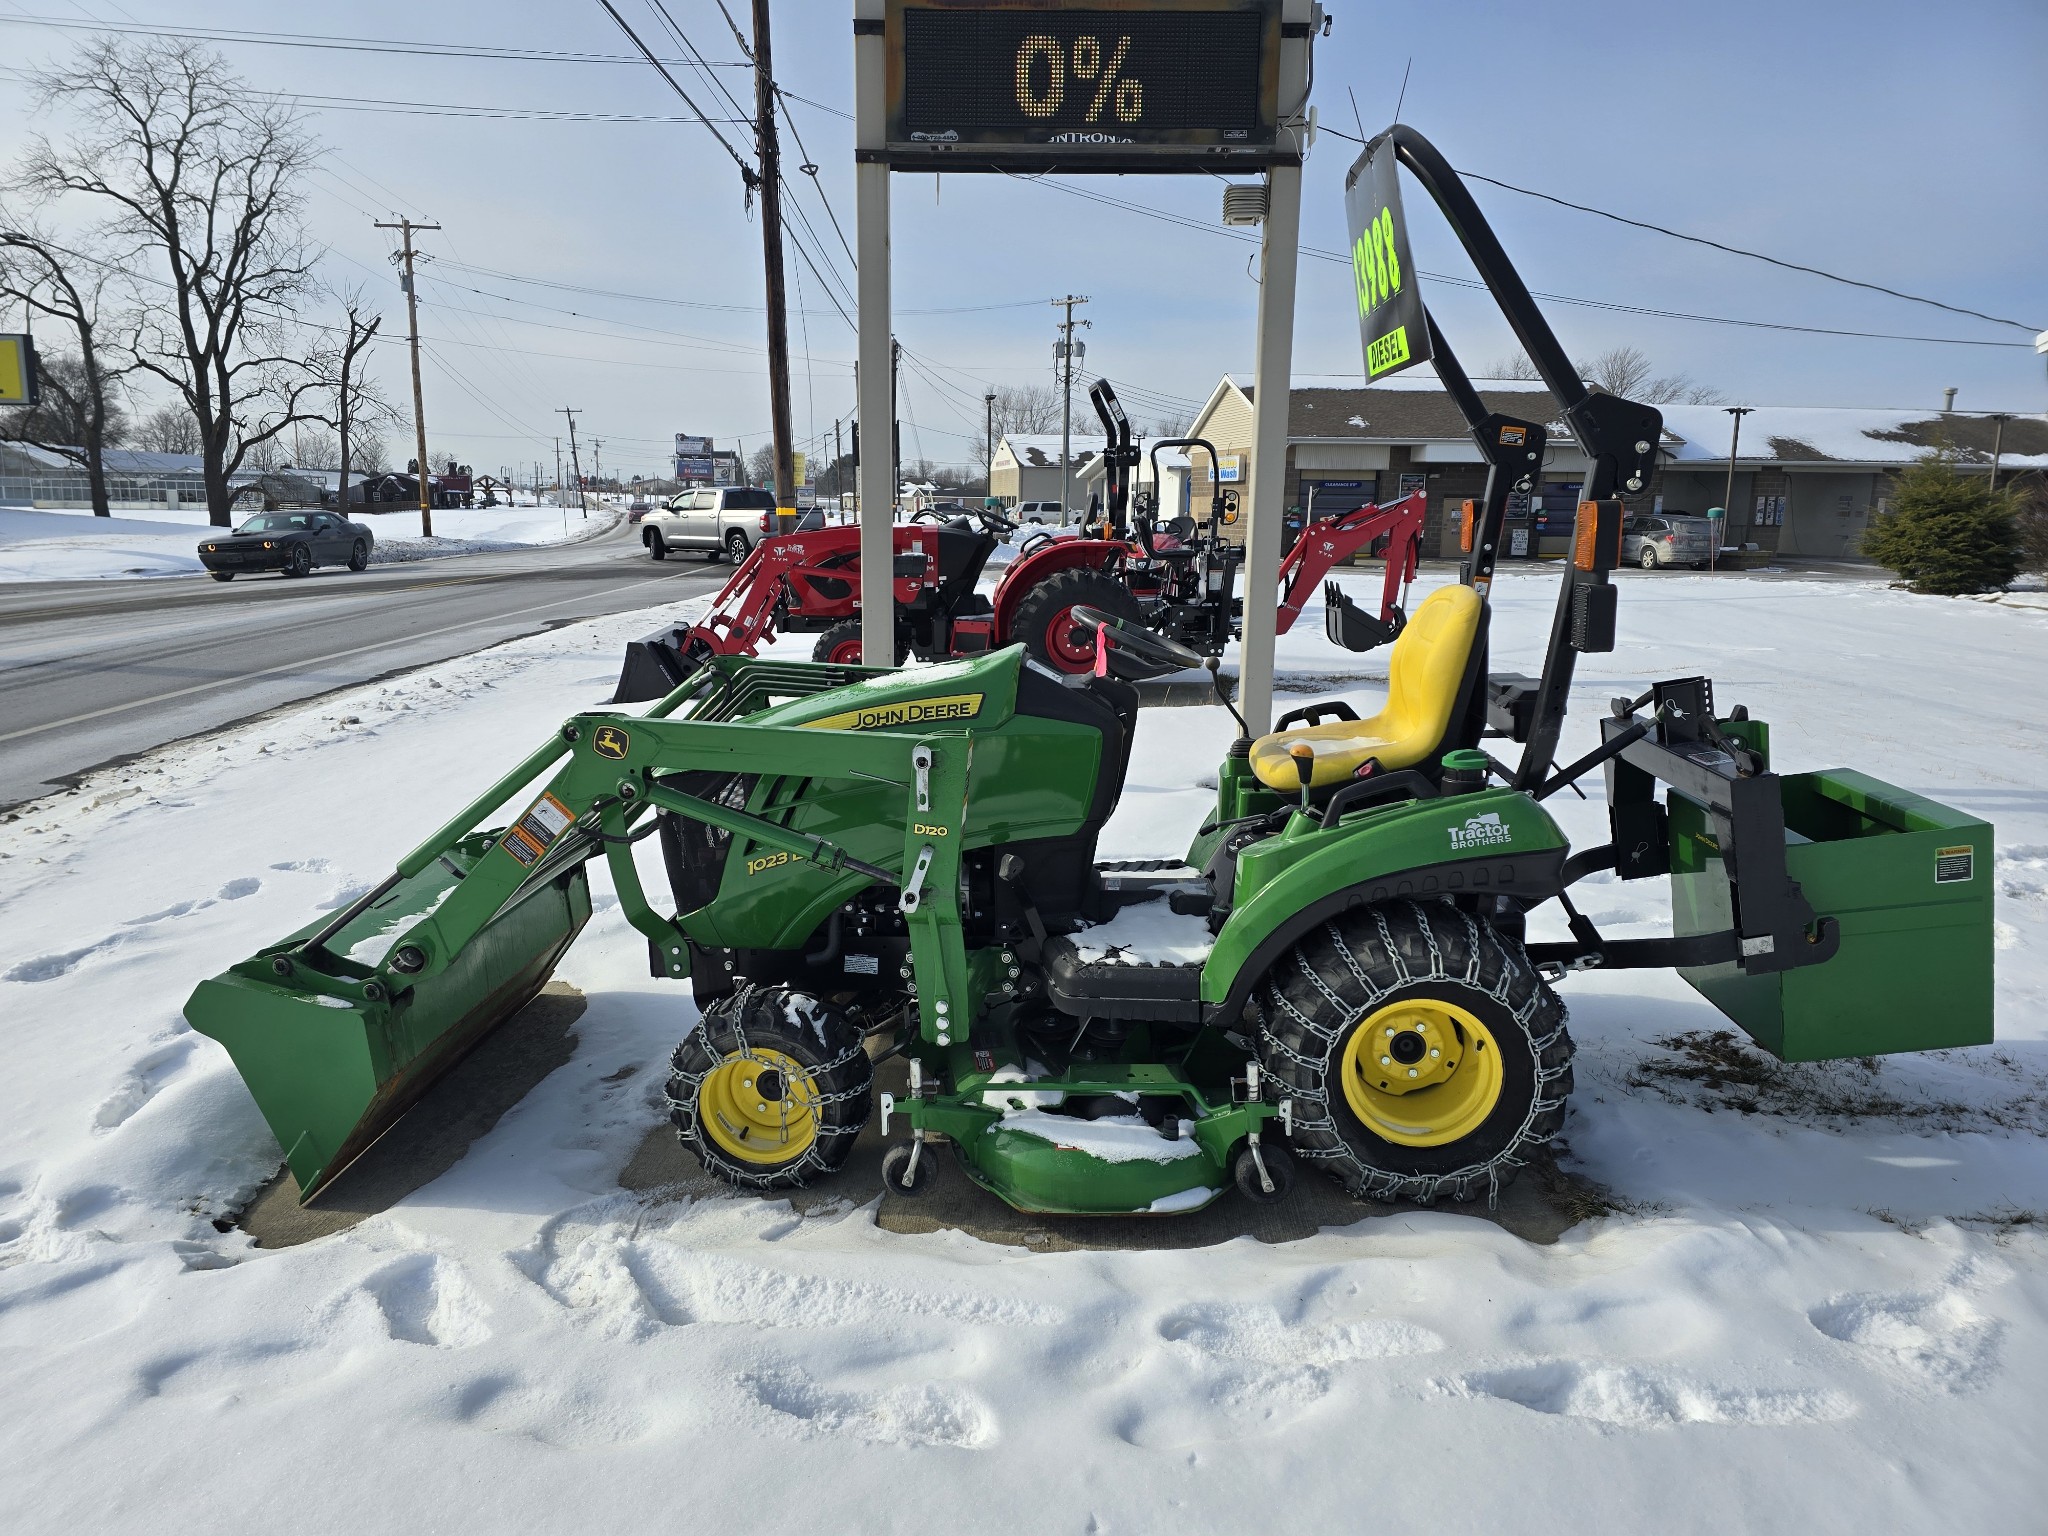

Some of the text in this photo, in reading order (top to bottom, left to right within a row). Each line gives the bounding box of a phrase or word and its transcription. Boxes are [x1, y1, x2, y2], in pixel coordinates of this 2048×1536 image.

[1015, 34, 1144, 123] 0%
[1352, 206, 1402, 318] 13988
[1371, 332, 1403, 371] DIESEL
[851, 702, 971, 729] JOHN DEERE
[913, 823, 948, 836] D120
[1447, 823, 1510, 841] Tractor
[1451, 835, 1512, 850] BROTHERS
[747, 851, 788, 876] 1023
